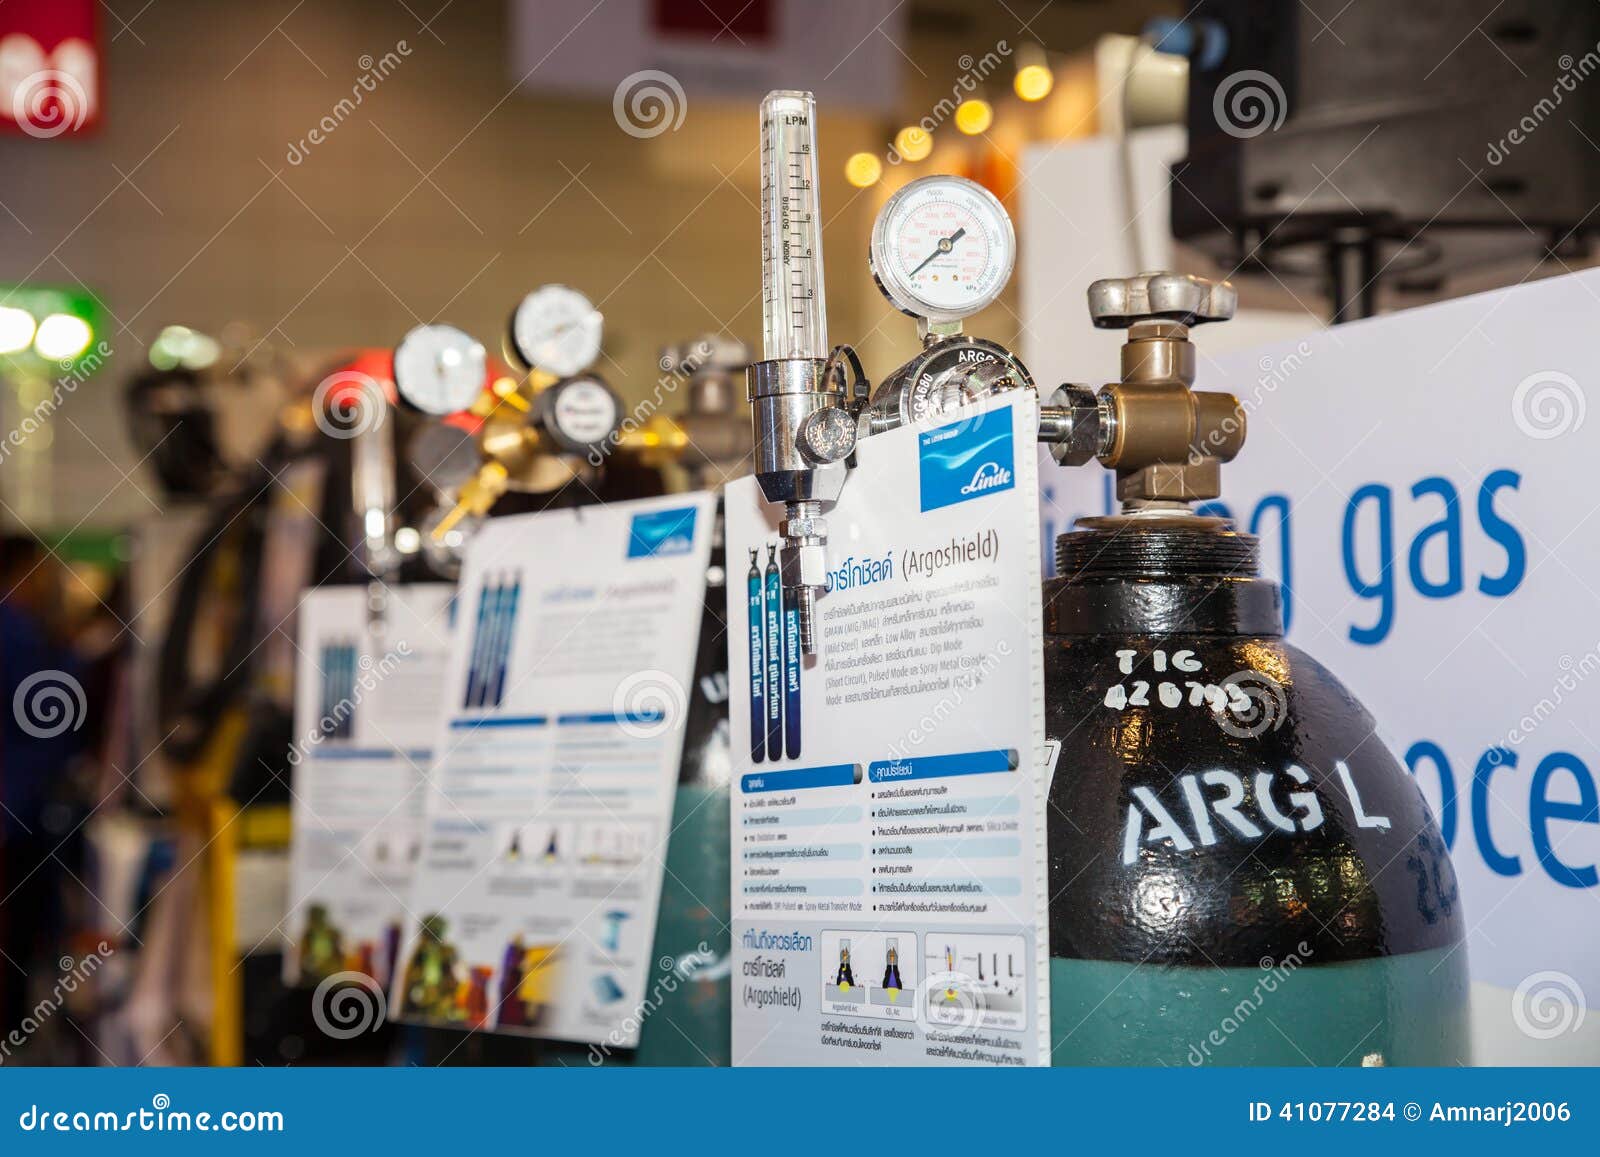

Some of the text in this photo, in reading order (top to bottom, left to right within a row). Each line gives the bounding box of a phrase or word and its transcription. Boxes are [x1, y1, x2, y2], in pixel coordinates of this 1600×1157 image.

[785, 115, 808, 127] LPM
[801, 179, 810, 188] 12
[782, 218, 789, 230] 50
[808, 288, 813, 297] 3
[914, 373, 933, 421] CGA680
[960, 461, 1011, 495] Linde
[902, 528, 999, 582] (Argoshield)
[1341, 468, 1527, 646] gas
[868, 668, 890, 682] Pulsed
[891, 665, 908, 679] Mode
[743, 985, 802, 1012] (Argoshield)
